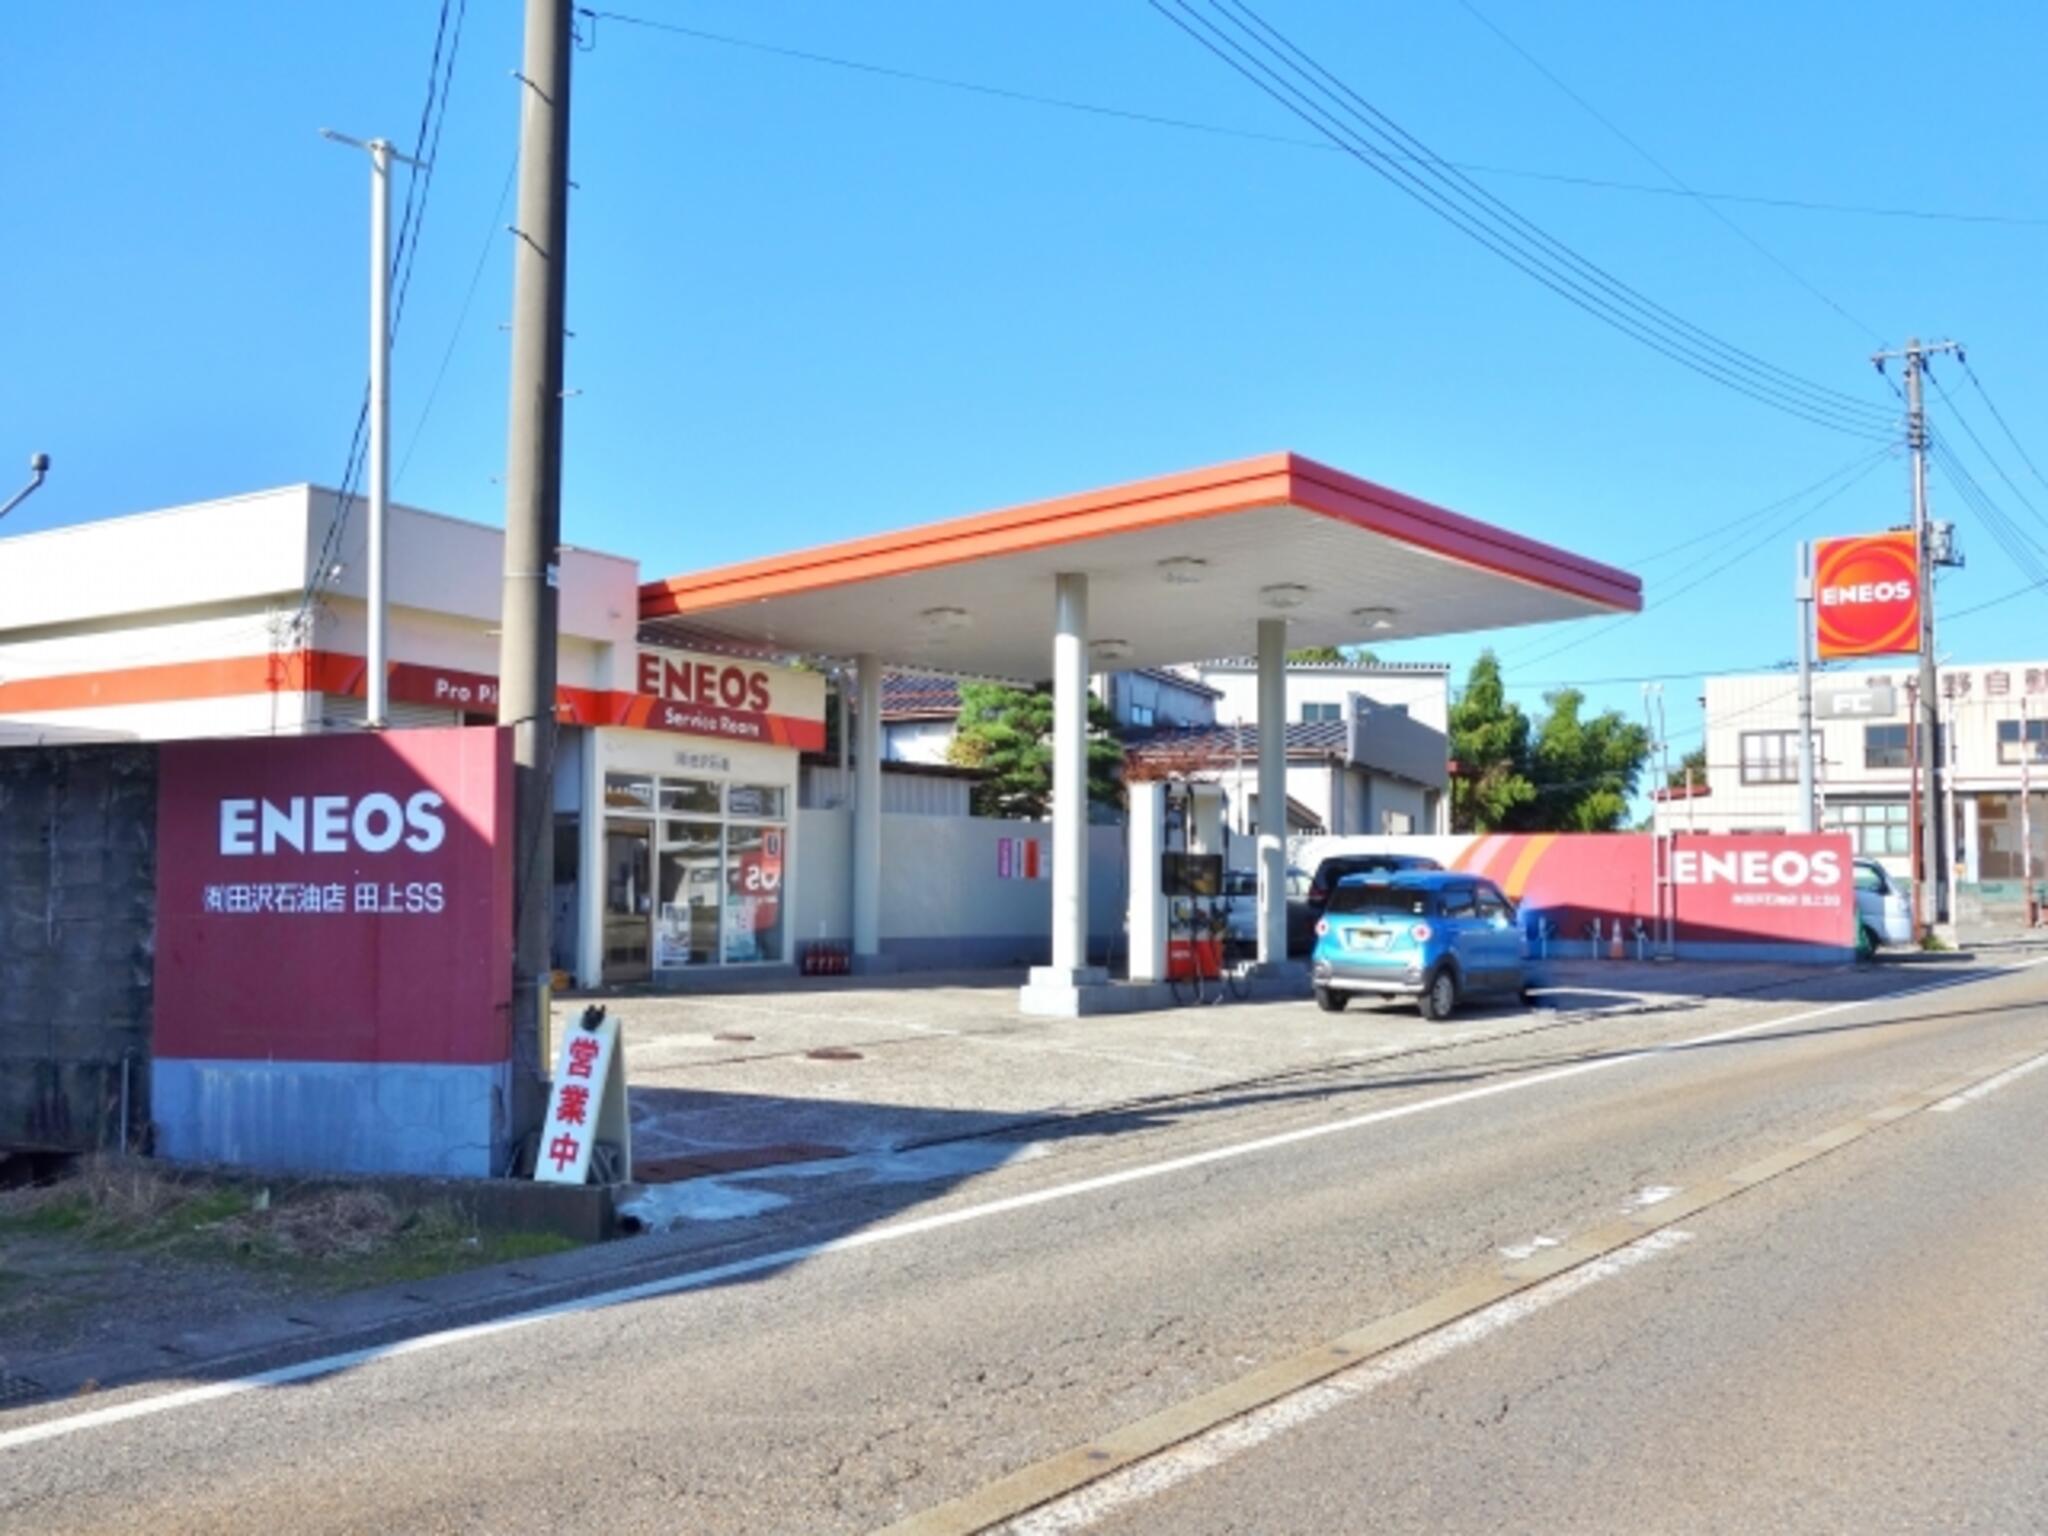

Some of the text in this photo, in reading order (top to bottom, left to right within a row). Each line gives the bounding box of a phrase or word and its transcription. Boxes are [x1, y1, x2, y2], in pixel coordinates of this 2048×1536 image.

[1822, 580, 1912, 606] ENEOS
[435, 679, 498, 705] Pro Pi
[638, 653, 771, 711] ENEOS
[665, 707, 760, 737] Service Room
[219, 790, 447, 856] ENEOS
[1672, 850, 1841, 887] ENEOS
[353, 882, 445, 913] 田上SS
[549, 1036, 600, 1174] 営業中
